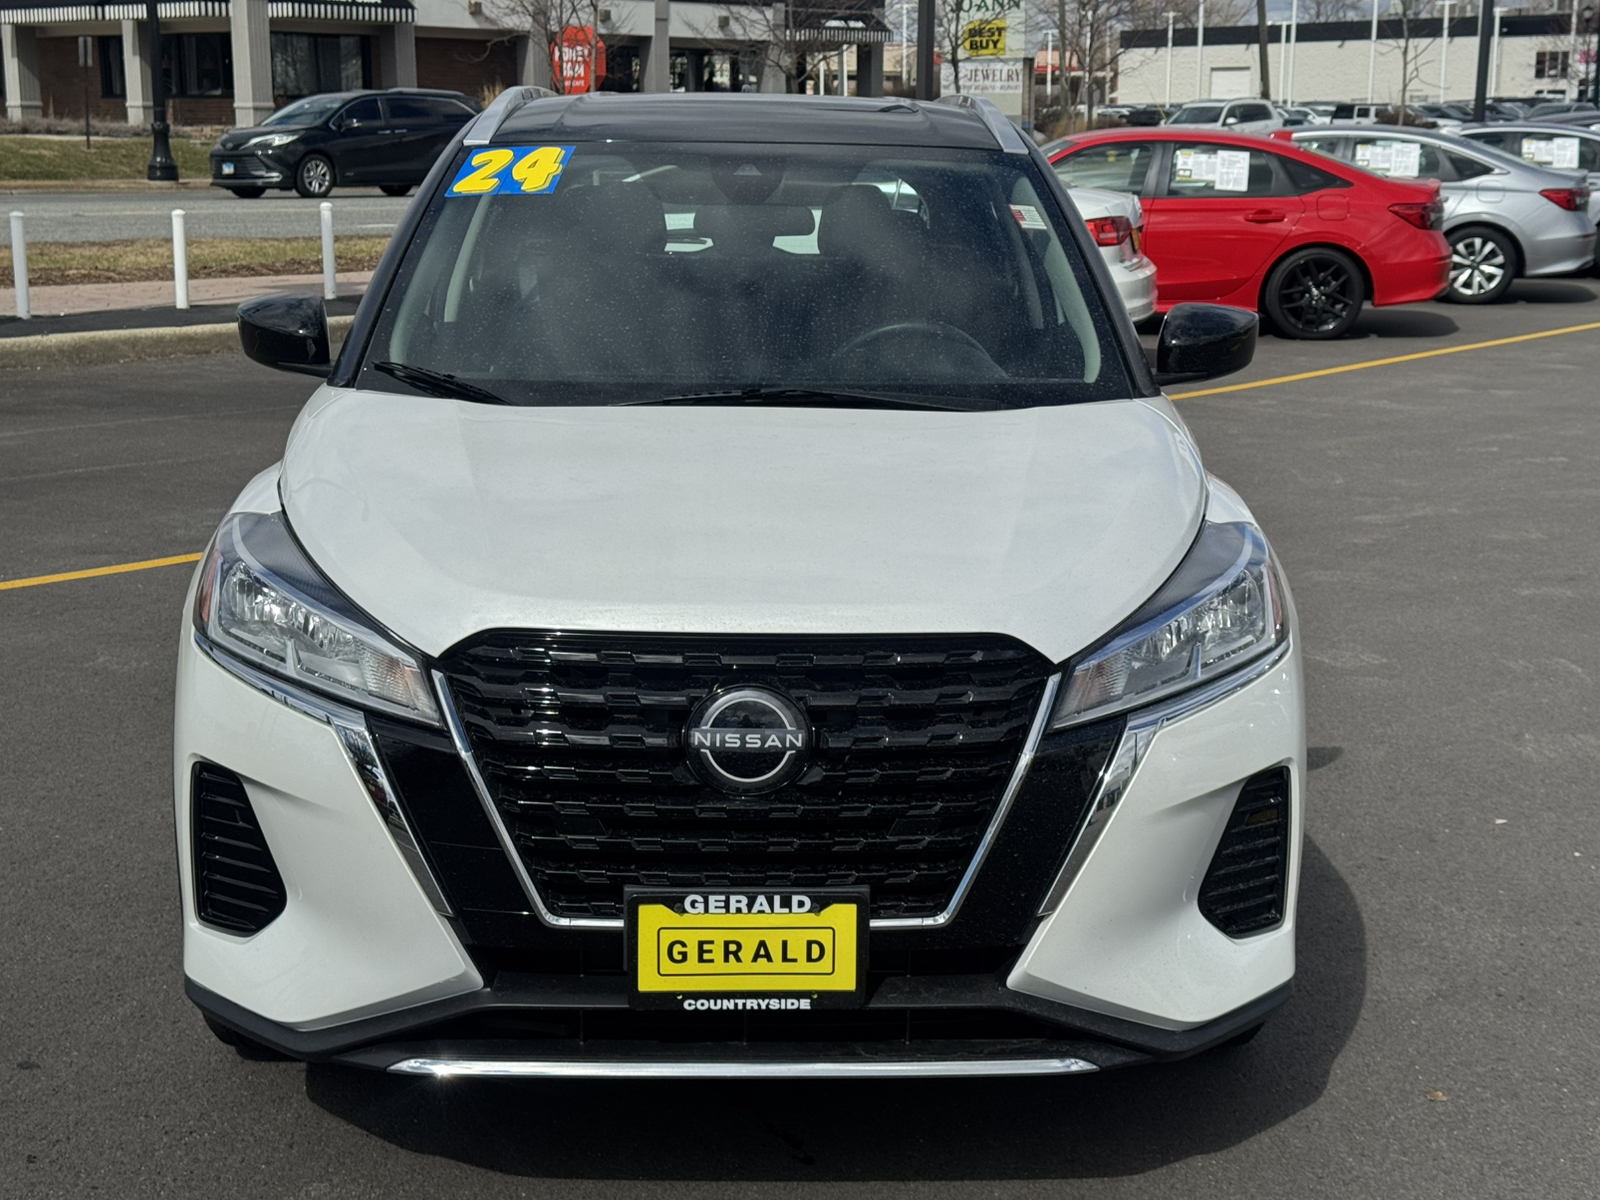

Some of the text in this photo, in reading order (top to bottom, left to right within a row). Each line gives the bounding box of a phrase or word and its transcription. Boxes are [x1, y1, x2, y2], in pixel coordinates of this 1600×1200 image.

[968, 27, 1006, 38] BEST
[970, 39, 1000, 50] BUY
[967, 68, 1021, 82] JEWELRY
[453, 147, 565, 194] 24
[694, 732, 803, 748] NISSAN
[683, 894, 812, 914] GERALD
[667, 939, 826, 964] GERALD
[683, 999, 811, 1010] COUNTRYSIDE
